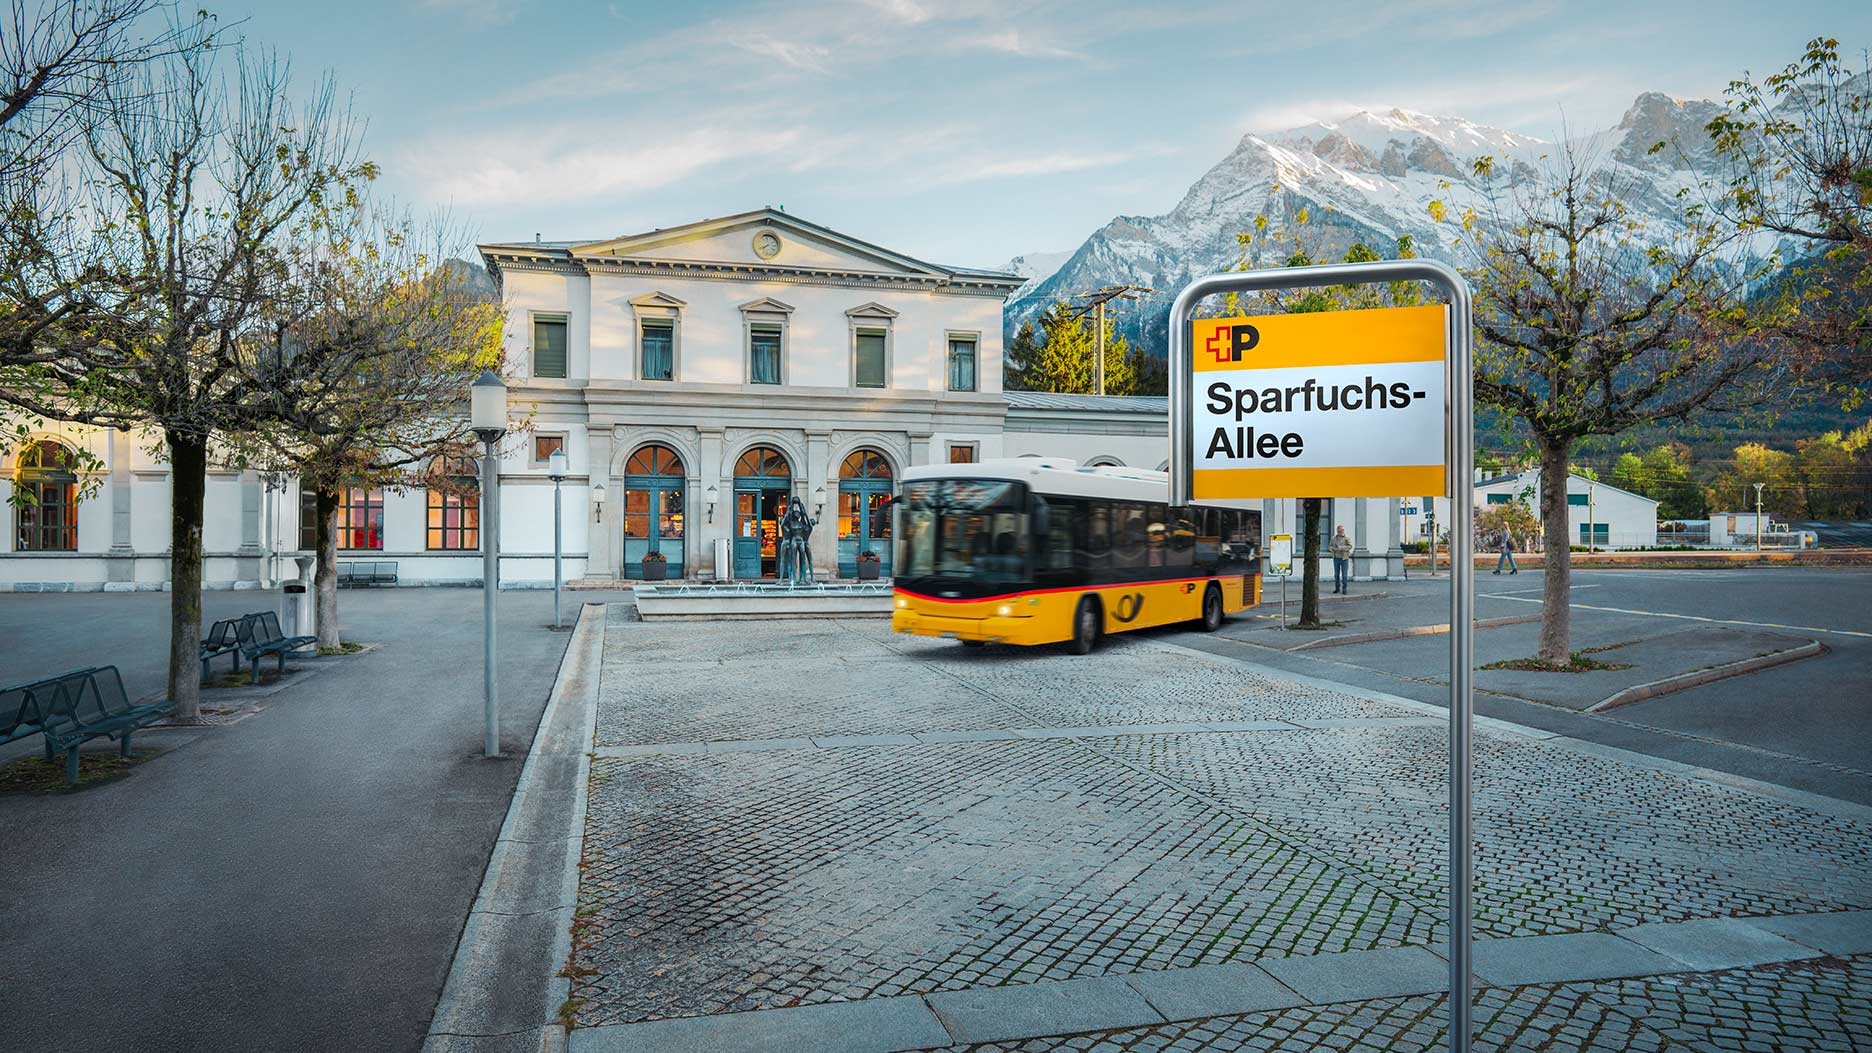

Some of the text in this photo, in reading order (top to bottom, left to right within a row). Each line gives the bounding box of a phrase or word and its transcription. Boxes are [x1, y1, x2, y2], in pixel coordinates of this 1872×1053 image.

[1231, 324, 1260, 362] P
[1206, 376, 1426, 421] Sparfuchs-
[1205, 426, 1304, 459] Allee
